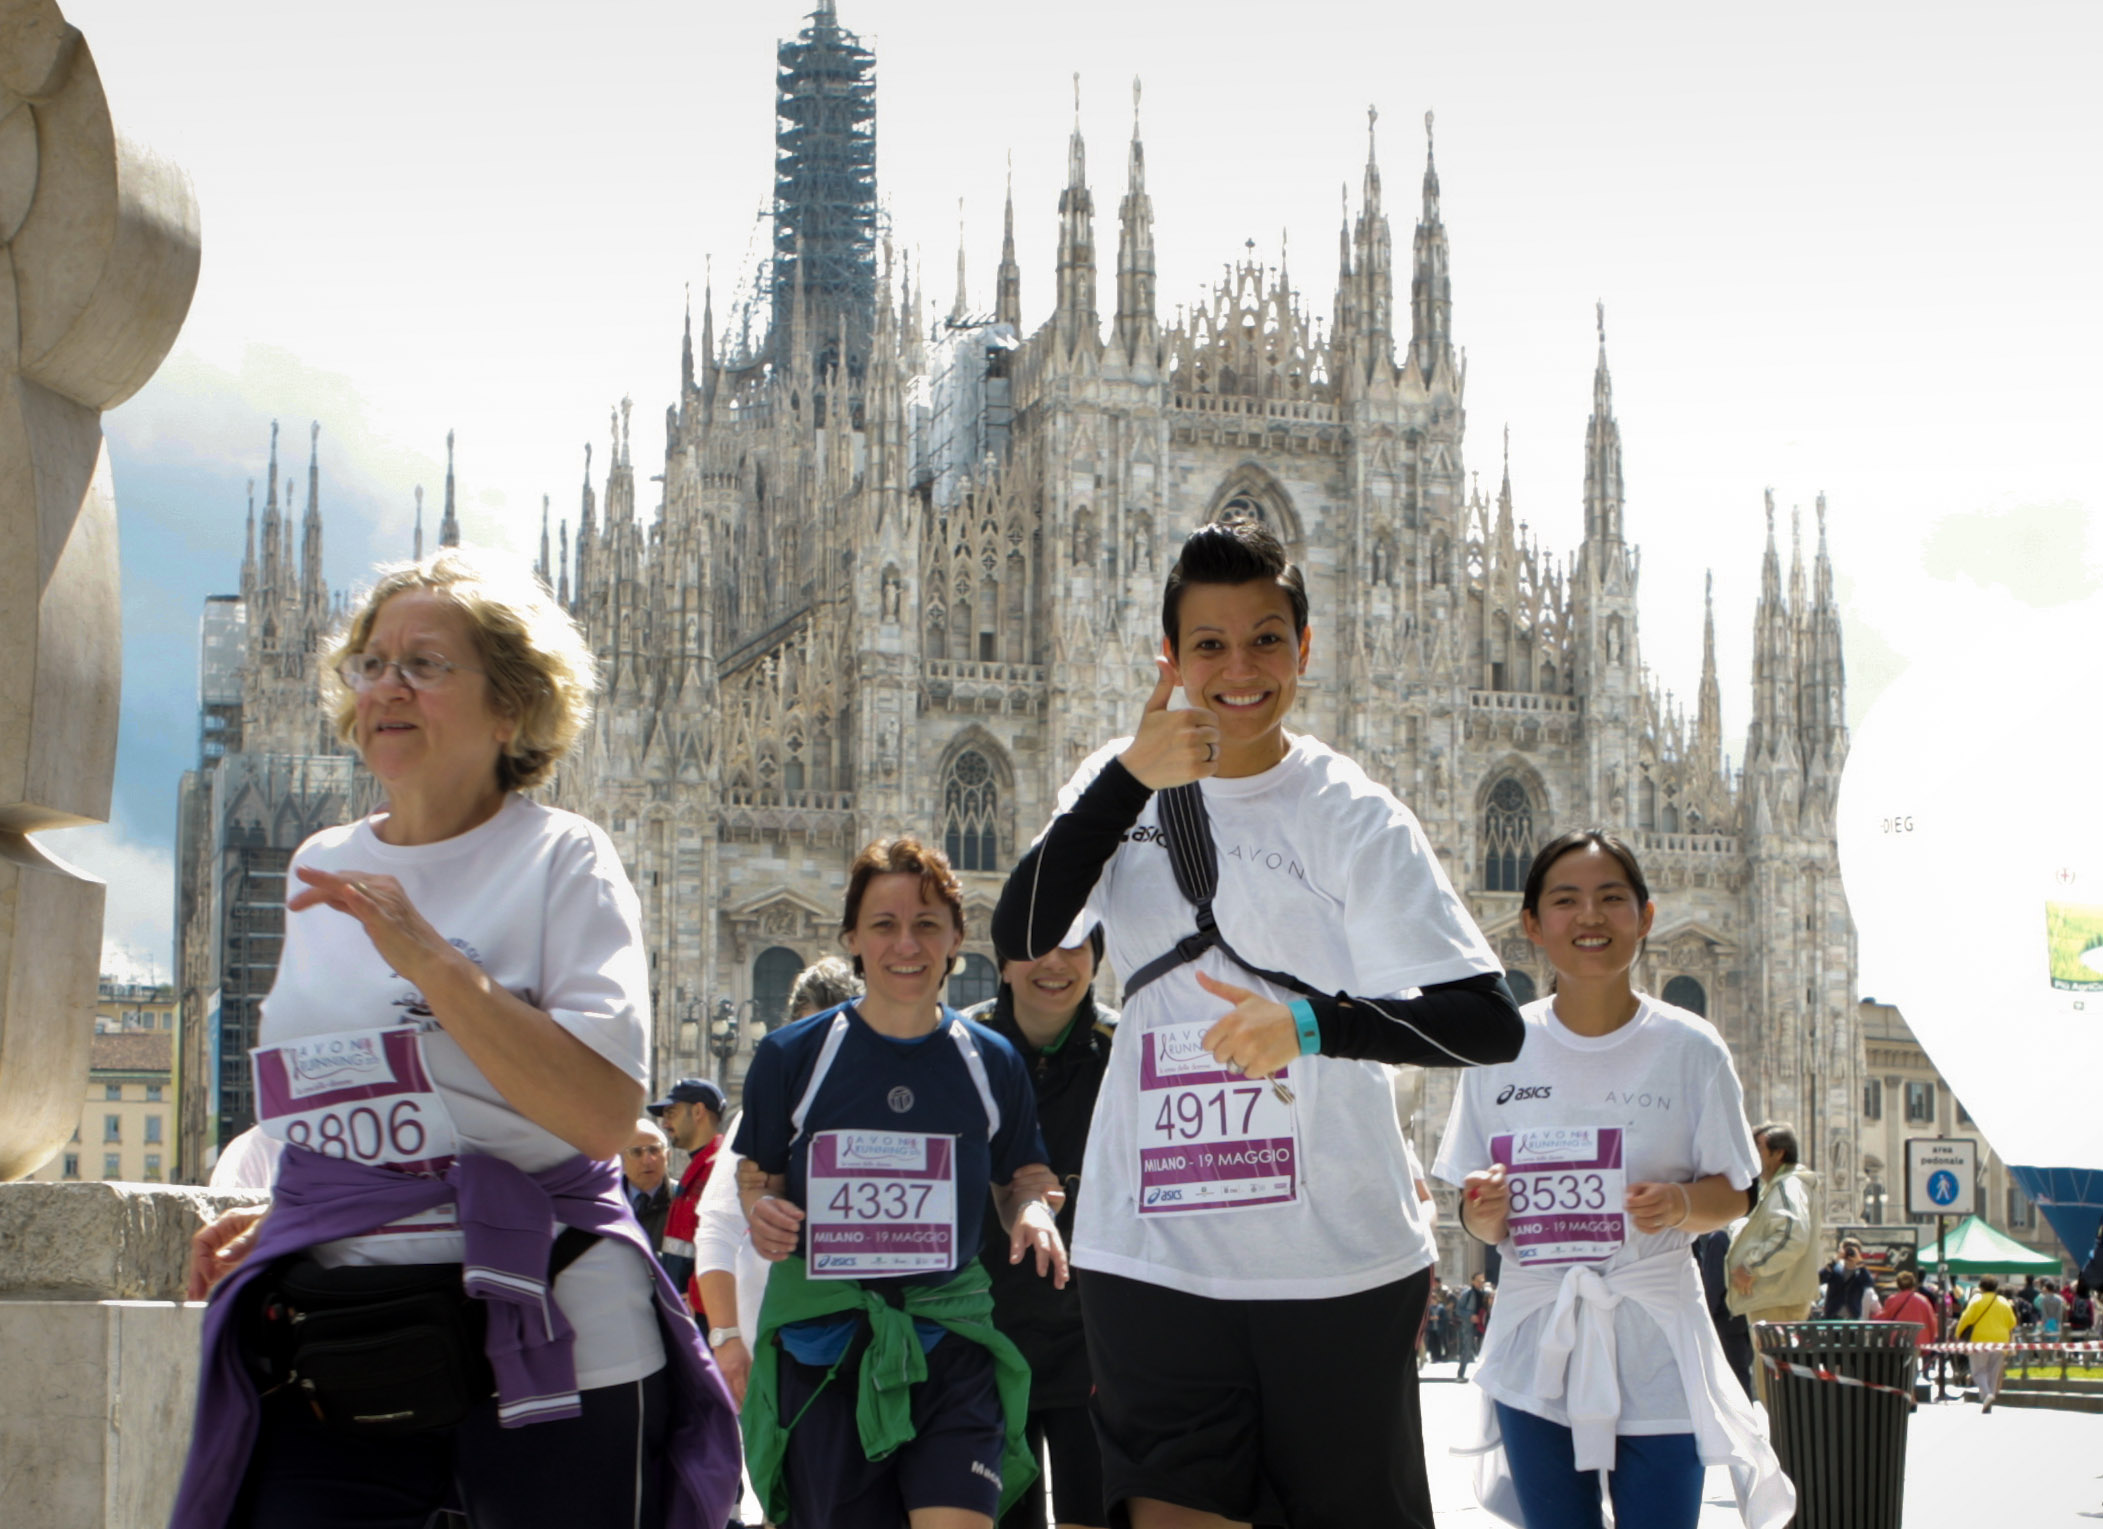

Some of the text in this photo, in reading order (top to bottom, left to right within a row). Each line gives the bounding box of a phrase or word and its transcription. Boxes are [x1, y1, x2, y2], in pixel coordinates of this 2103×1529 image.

[1132, 826, 1167, 849] asic
[1228, 845, 1304, 879] AVON
[1169, 1029, 1209, 1042] AVO
[1169, 1043, 1204, 1055] RUNN
[1605, 1091, 1671, 1111] AVON
[1155, 1087, 1262, 1140] 4917
[286, 1100, 426, 1160] 8806
[1144, 1155, 1187, 1173] MILANO
[1199, 1154, 1214, 1168] 19
[1217, 1148, 1290, 1167] MAGGIO
[1921, 1156, 1964, 1166] pedonale
[828, 1182, 934, 1220] 4337
[1508, 1174, 1606, 1213] 8533
[814, 1231, 865, 1243] MILANO
[876, 1231, 889, 1243] 19
[891, 1231, 948, 1243] MAGGIO
[1553, 1221, 1566, 1232] 19
[1568, 1221, 1621, 1232] MAGGIO
